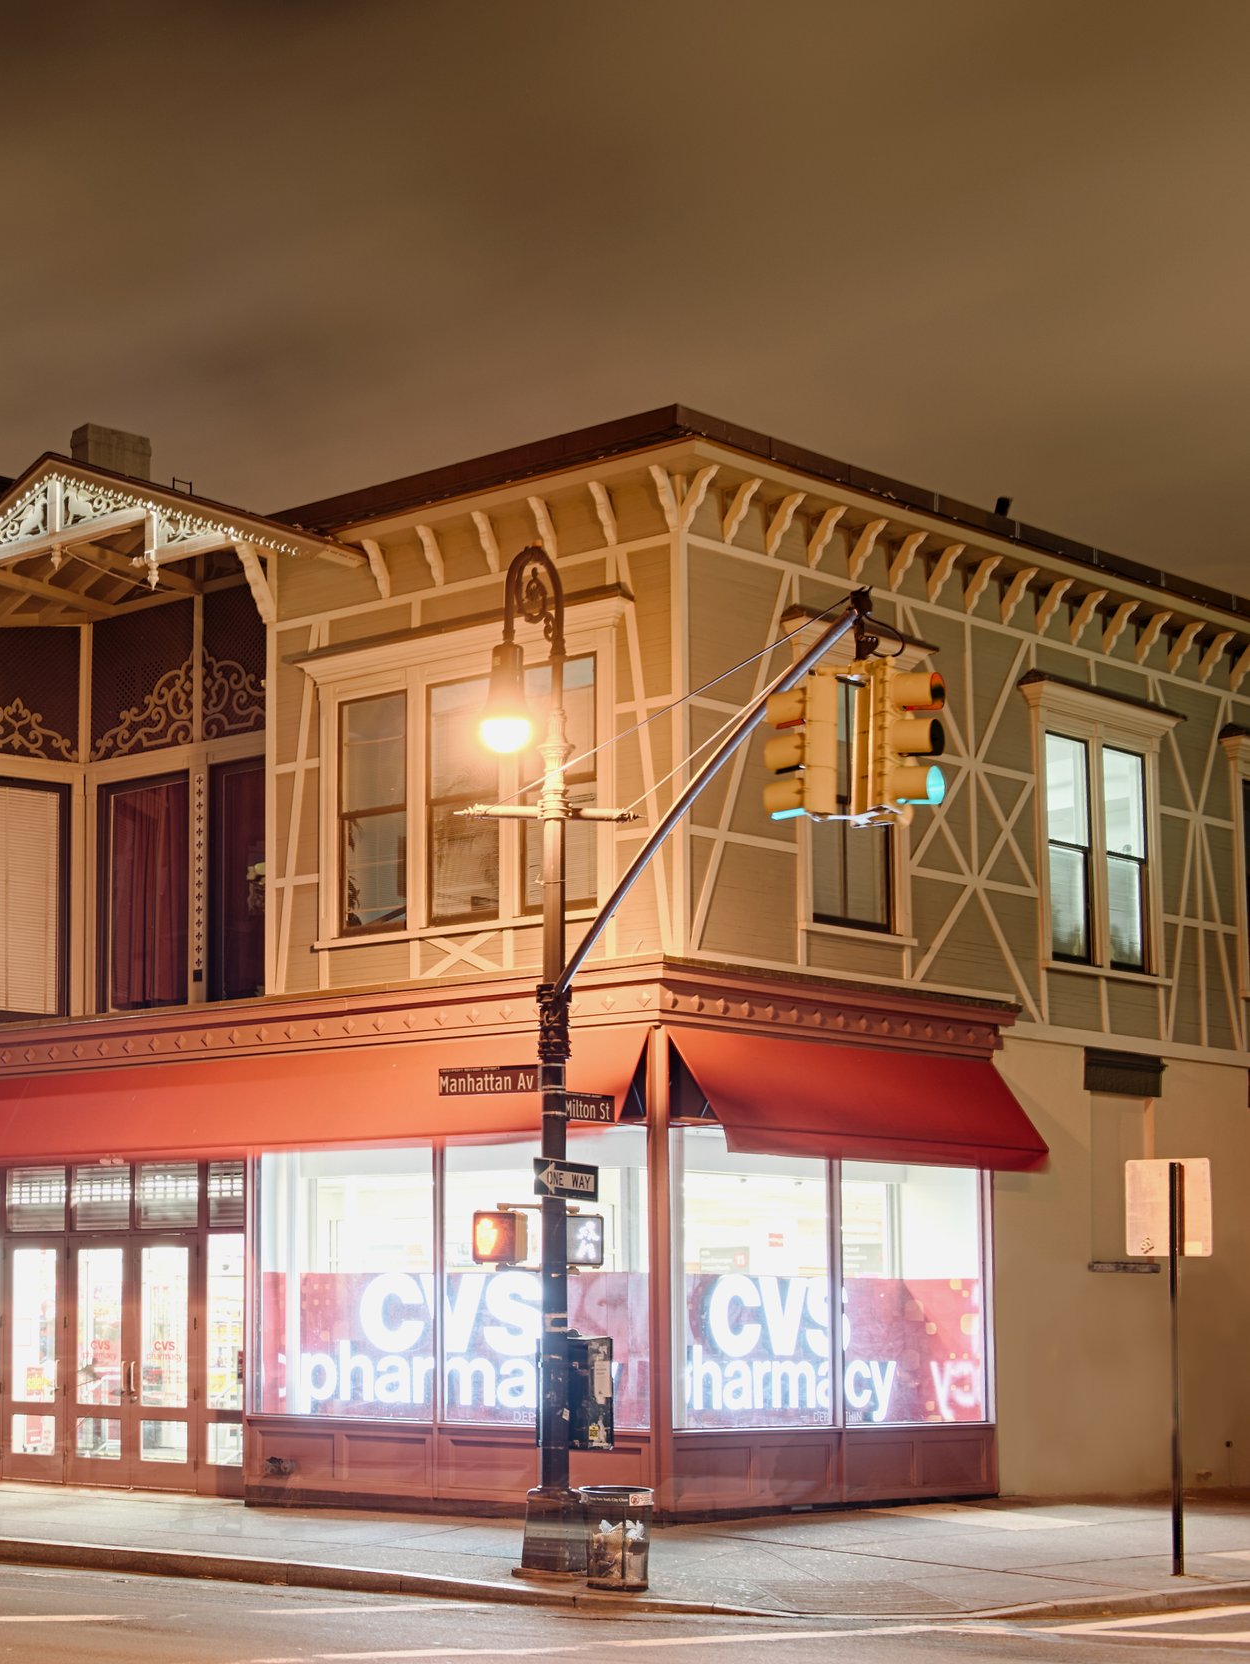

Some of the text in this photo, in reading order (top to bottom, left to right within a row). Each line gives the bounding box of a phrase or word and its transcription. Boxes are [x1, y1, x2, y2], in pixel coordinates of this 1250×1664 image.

[439, 1073, 534, 1093] Manhattan Av
[565, 1098, 610, 1120] Milton St
[546, 1171, 591, 1190] ONE WAY
[360, 1271, 544, 1355] CVS
[709, 1273, 851, 1357] CVS
[154, 1341, 176, 1351] CVS
[513, 1411, 536, 1422] DEP
